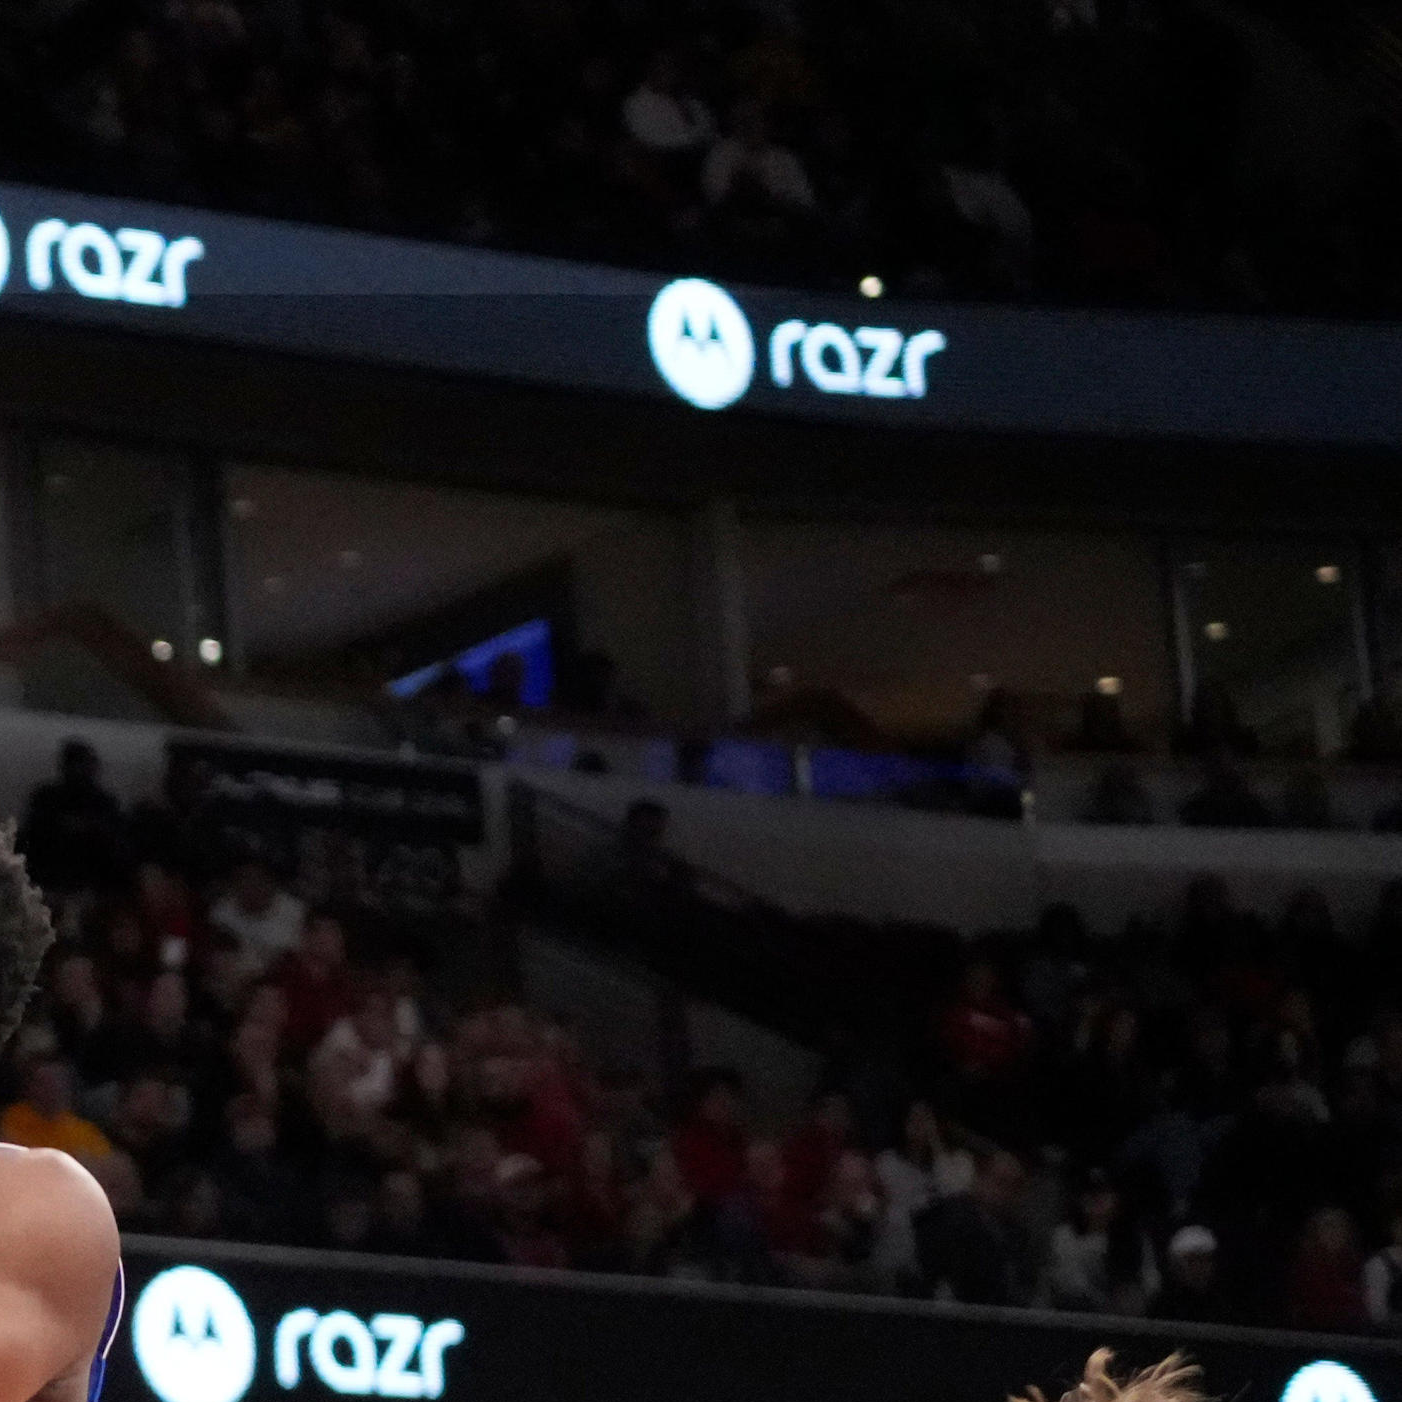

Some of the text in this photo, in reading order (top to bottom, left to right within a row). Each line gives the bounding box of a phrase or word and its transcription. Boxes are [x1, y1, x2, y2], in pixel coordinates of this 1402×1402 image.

[25, 217, 205, 309] razr
[769, 318, 946, 398] razr
[274, 1307, 466, 1400] razr
